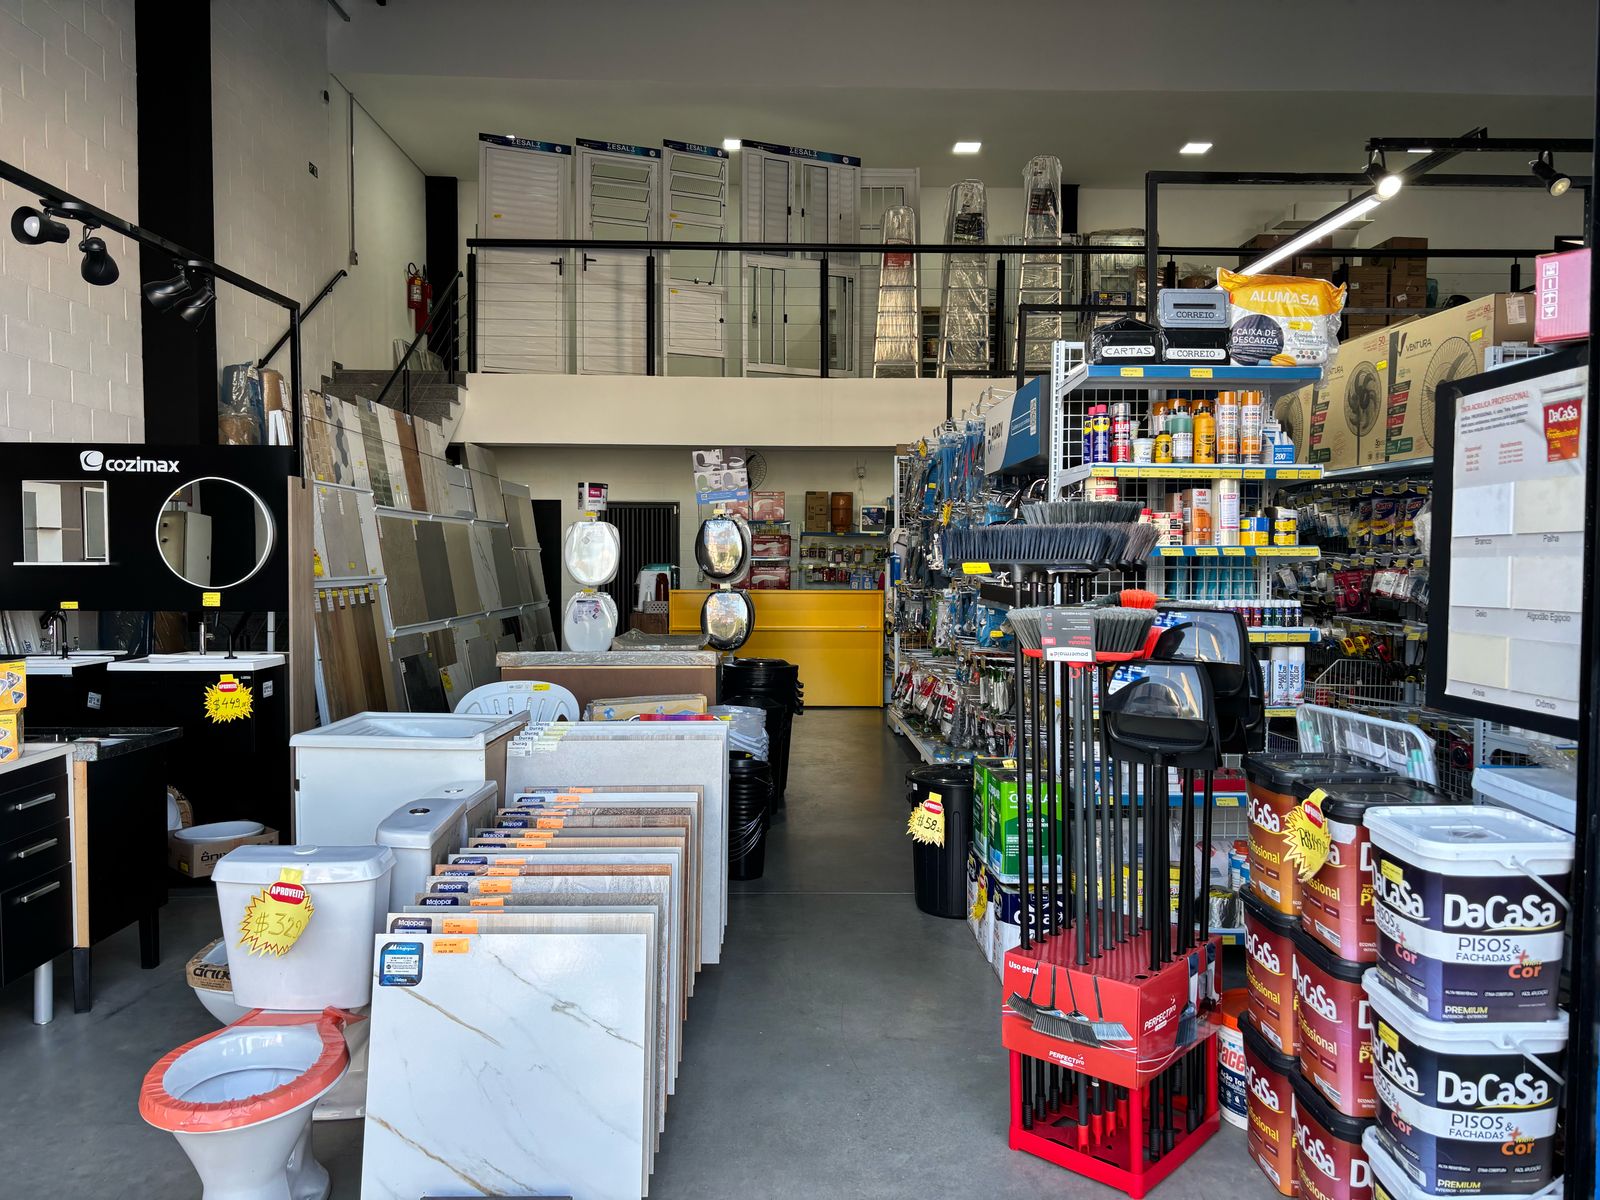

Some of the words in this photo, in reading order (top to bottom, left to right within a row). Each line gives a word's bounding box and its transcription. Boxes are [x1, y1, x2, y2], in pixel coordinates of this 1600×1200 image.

[1250, 290, 1319, 306] ALUMASA
[1176, 311, 1215, 319] CORREIO
[1236, 328, 1262, 337] CAIXA
[1264, 329, 1277, 337] DE
[1232, 336, 1279, 345] DESCARGA
[1406, 338, 1432, 352] VENTURA
[1105, 347, 1152, 355] CARTAS
[1176, 350, 1216, 358] CORREIO
[1548, 405, 1578, 423] DaCaSa
[105, 456, 180, 472] cozimax
[1543, 534, 1560, 543] Palha
[271, 886, 304, 899] APROVEITE
[437, 883, 463, 891] Majopar
[1443, 893, 1557, 930] DaCaSa
[398, 919, 426, 927] Majopar
[1458, 937, 1511, 953] PISOS
[1512, 945, 1520, 954] &
[1456, 953, 1511, 962] FACHADAS
[1008, 960, 1020, 970] Uso
[1021, 964, 1039, 976] geral
[1508, 964, 1542, 979] Cor
[1444, 1005, 1489, 1015] PREMIUM
[1144, 1004, 1177, 1031] PERFECTpro
[1049, 1050, 1085, 1066] PERFECTpro
[1246, 1065, 1280, 1112] aCaSa
[1437, 1070, 1549, 1106] DaCaSa
[1451, 1113, 1504, 1130] PISOS
[1505, 1122, 1514, 1132] &
[1449, 1128, 1504, 1140] FACHADAS
[1501, 1140, 1535, 1156] Cor
[1437, 1179, 1481, 1189] PREMIUM
